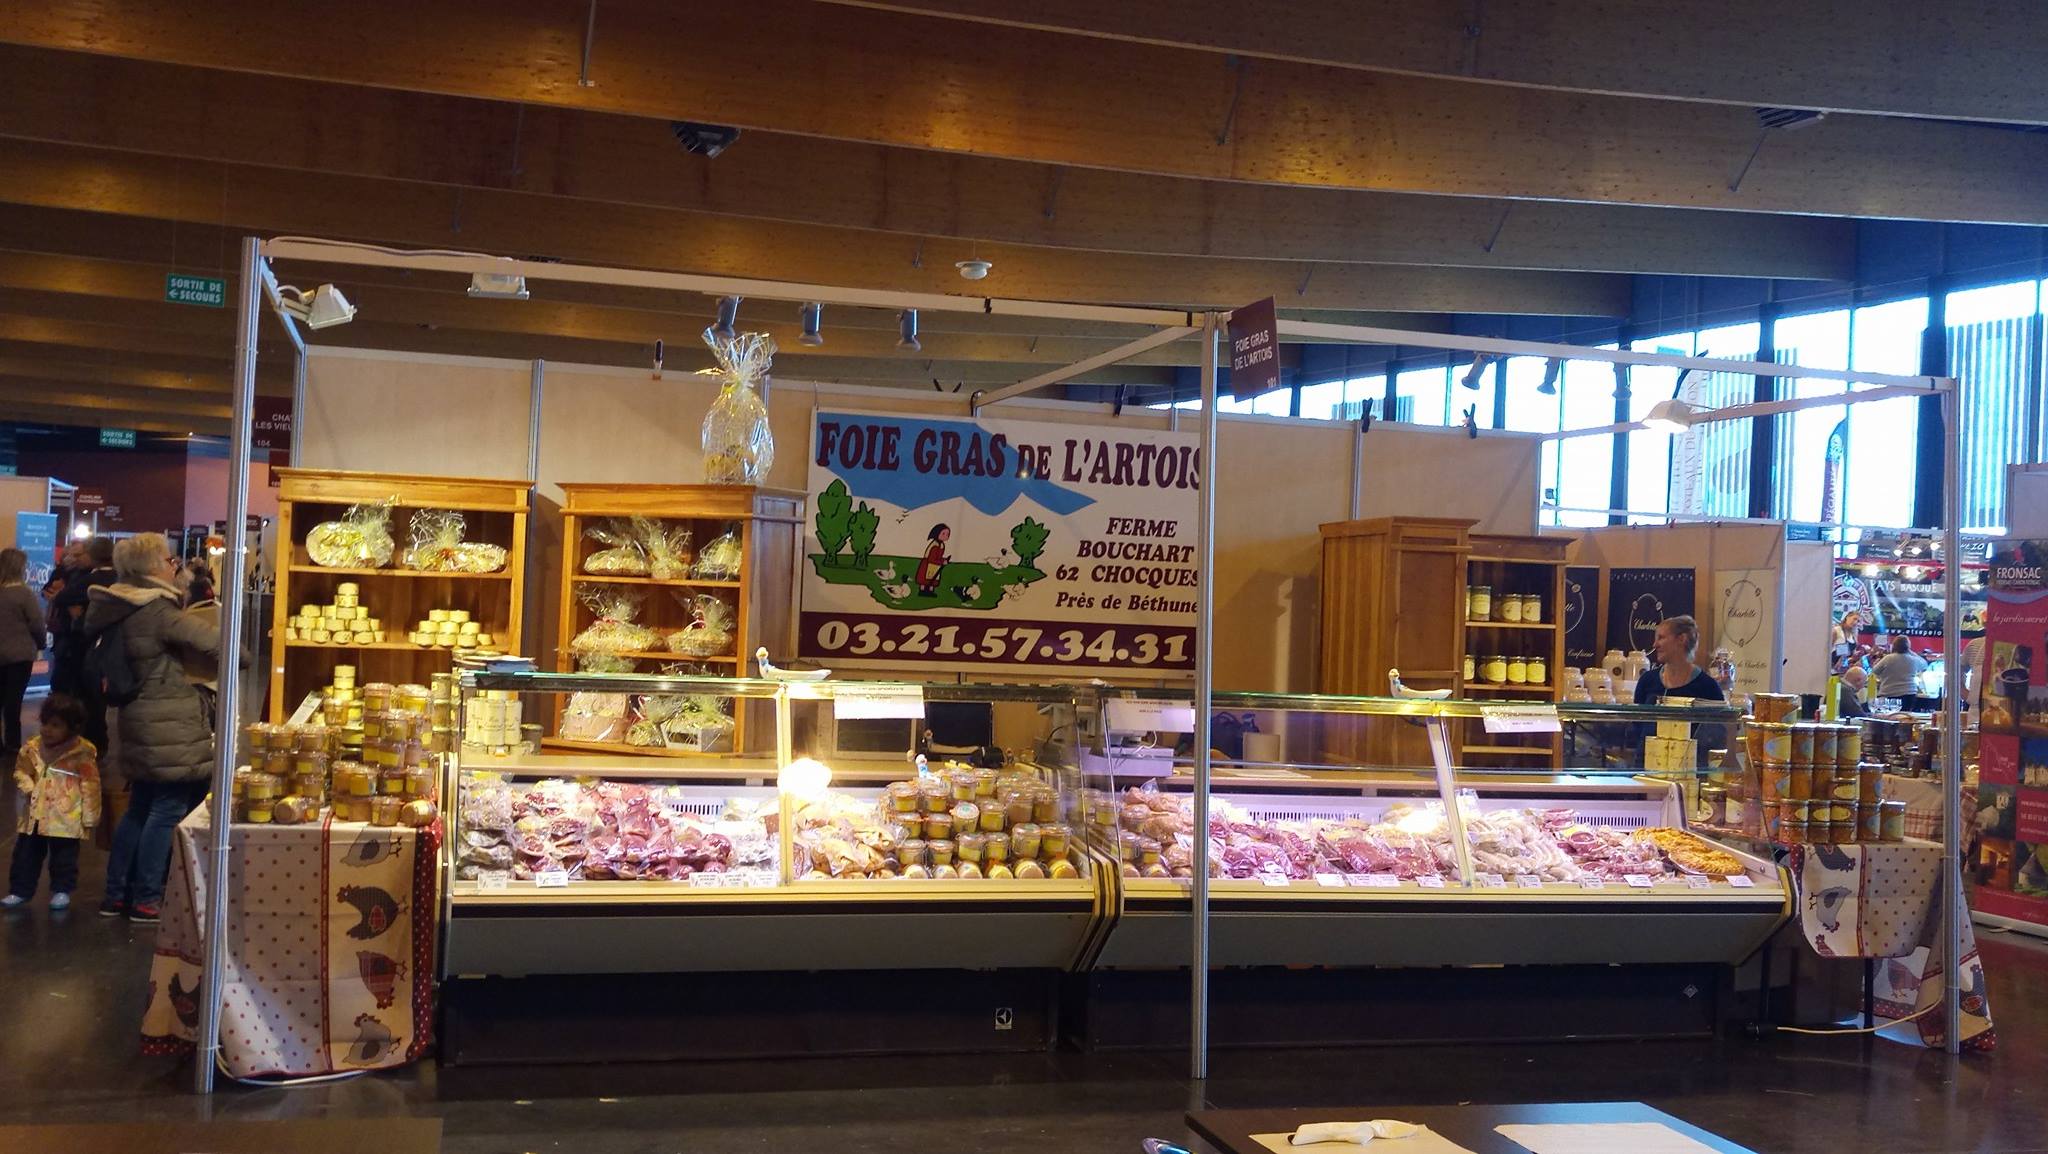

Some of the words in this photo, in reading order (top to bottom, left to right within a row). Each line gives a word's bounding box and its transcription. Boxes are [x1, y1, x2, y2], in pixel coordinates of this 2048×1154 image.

[171, 278, 204, 291] SORTIE
[209, 282, 222, 292] DE
[180, 290, 221, 303] SECOURS
[1235, 336, 1250, 353] FOIE
[1250, 330, 1269, 348] GRAS
[1234, 356, 1244, 371] DE
[1244, 346, 1273, 368] L'ARTOIS
[255, 421, 272, 430] LES
[816, 422, 901, 471] FOIE
[913, 429, 1007, 478] GRAS
[1016, 444, 1052, 481] DE
[1105, 517, 1177, 538] FERME
[1076, 540, 1195, 563] BOUCHART
[1055, 564, 1079, 581] 62
[1996, 567, 2041, 579] FRONSAC
[1901, 583, 1937, 593] BASQUE
[1055, 592, 1095, 609] Près
[1101, 594, 1122, 609] de
[1128, 595, 1198, 613] Béthune
[816, 620, 1190, 664] 03.21.57.34.31
